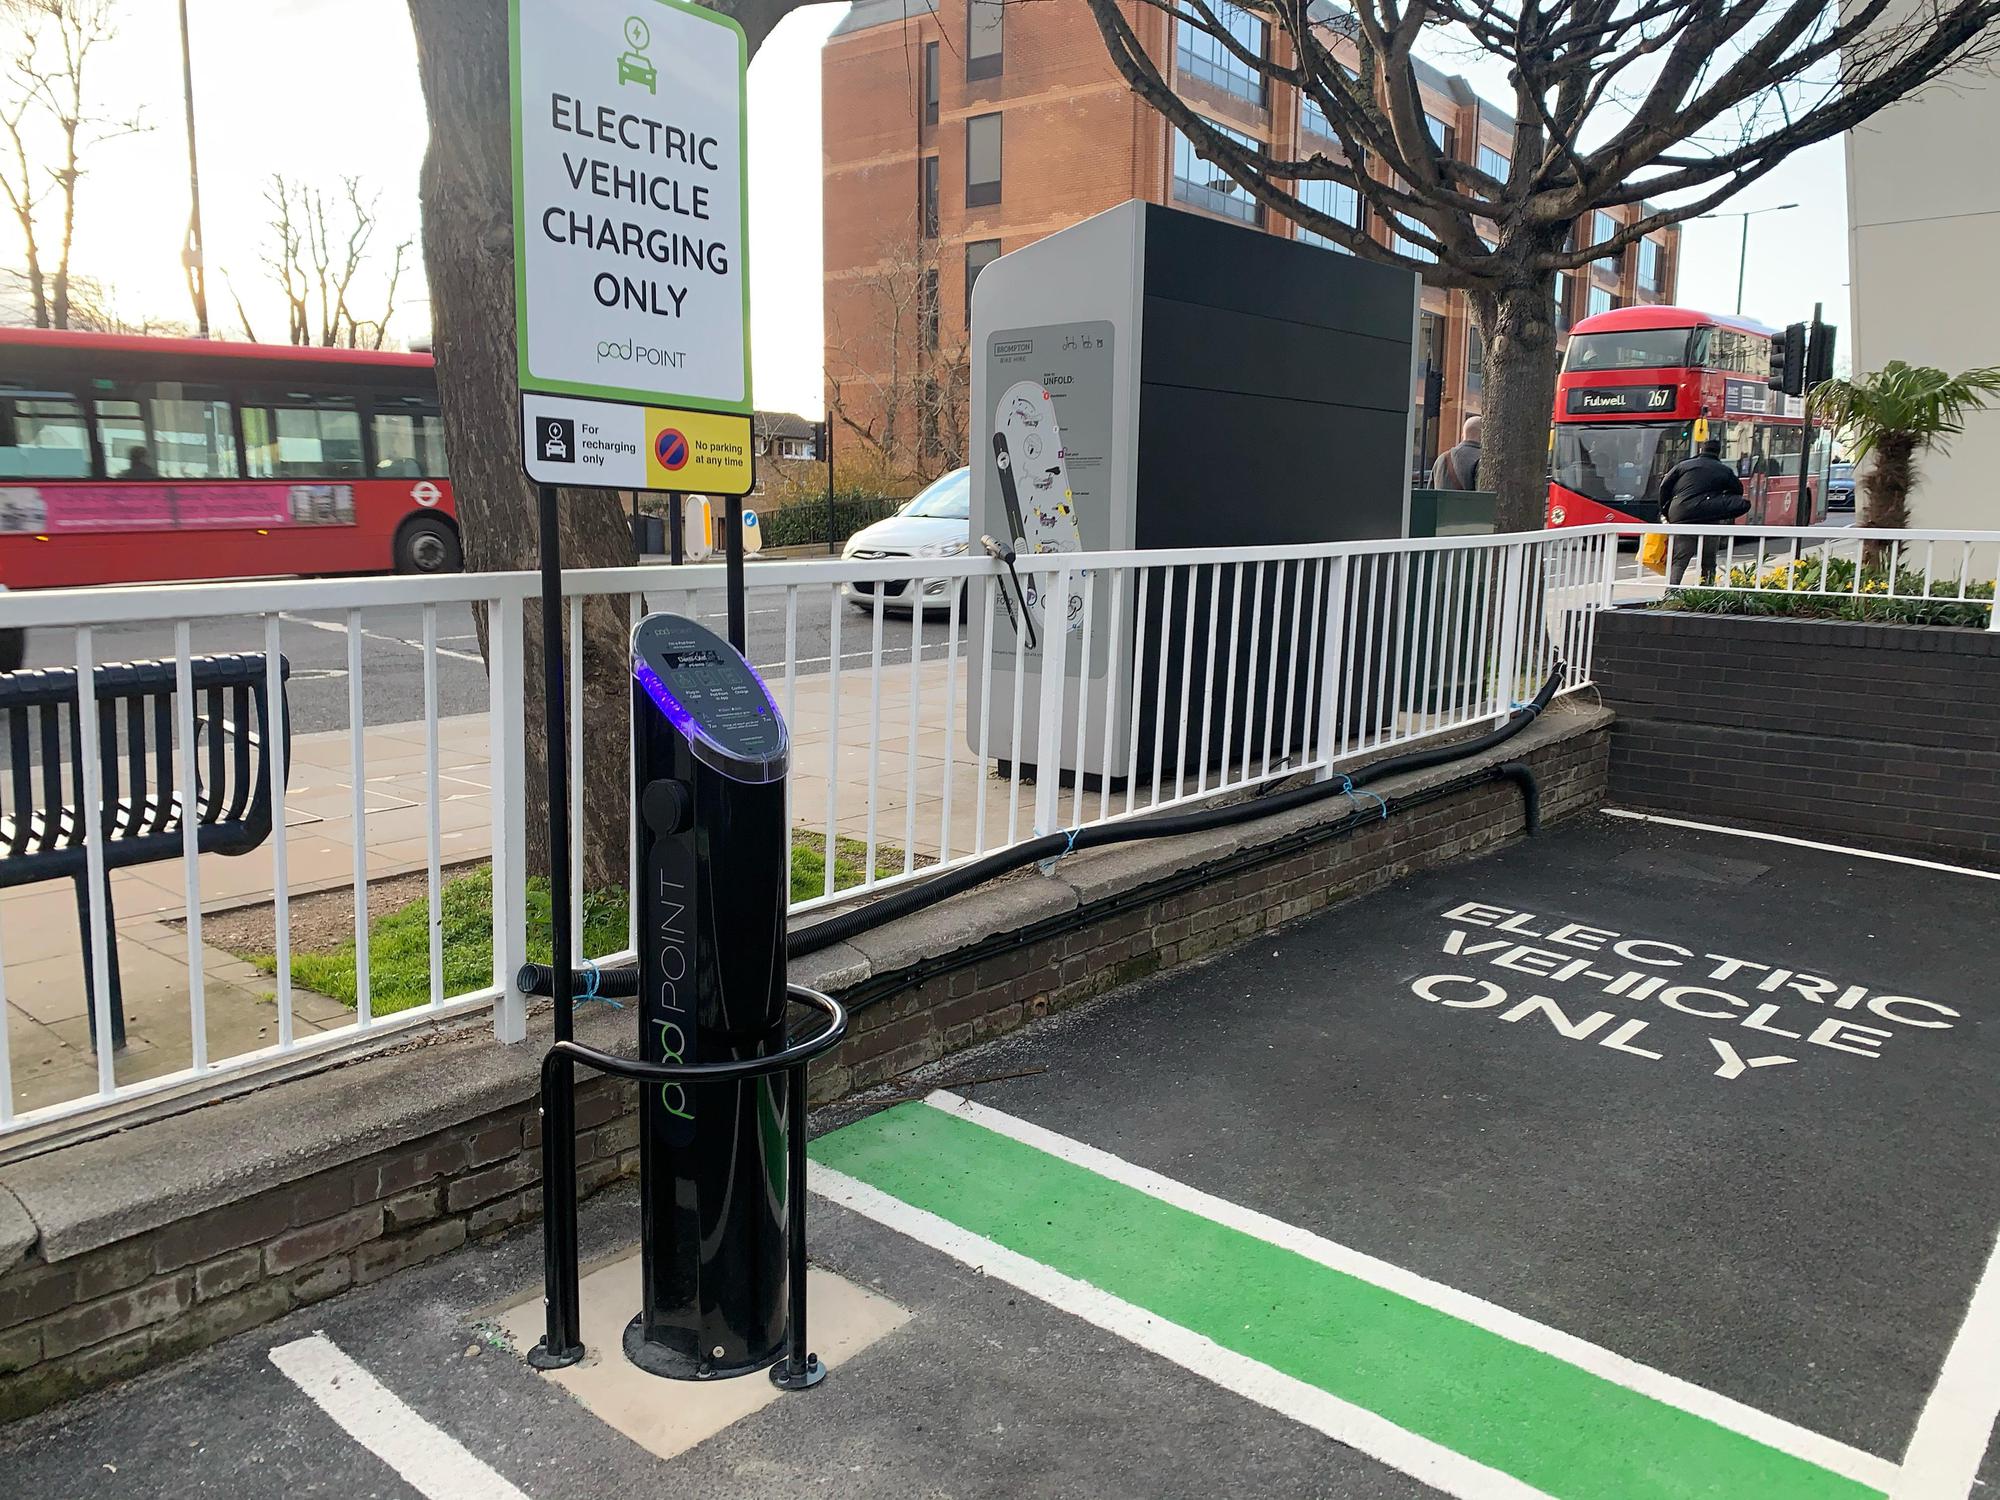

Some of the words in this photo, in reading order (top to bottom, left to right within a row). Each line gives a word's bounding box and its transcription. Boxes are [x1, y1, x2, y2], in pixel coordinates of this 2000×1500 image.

[552, 92, 718, 170] ELECTRIC
[562, 152, 709, 220] VEHICLE
[542, 206, 728, 275] CHARGING
[593, 272, 687, 318] ONLY
[597, 337, 632, 363] pod
[636, 346, 687, 369] POINT
[996, 343, 1031, 354] BROMPTON
[1583, 394, 1626, 407] Fulwell
[1647, 389, 1670, 407] 267
[582, 423, 599, 435] For
[582, 439, 636, 455] recharging
[695, 440, 707, 450] No
[710, 443, 743, 456] parking
[582, 453, 605, 467] only
[695, 455, 704, 464] at
[706, 457, 721, 468] any
[724, 457, 743, 467] time
[660, 868, 686, 1013] POINT
[1441, 901, 1961, 1029] ELECTRIC
[1442, 929, 1893, 1058] VEHICLE
[1411, 974, 1798, 1080] ONLY
